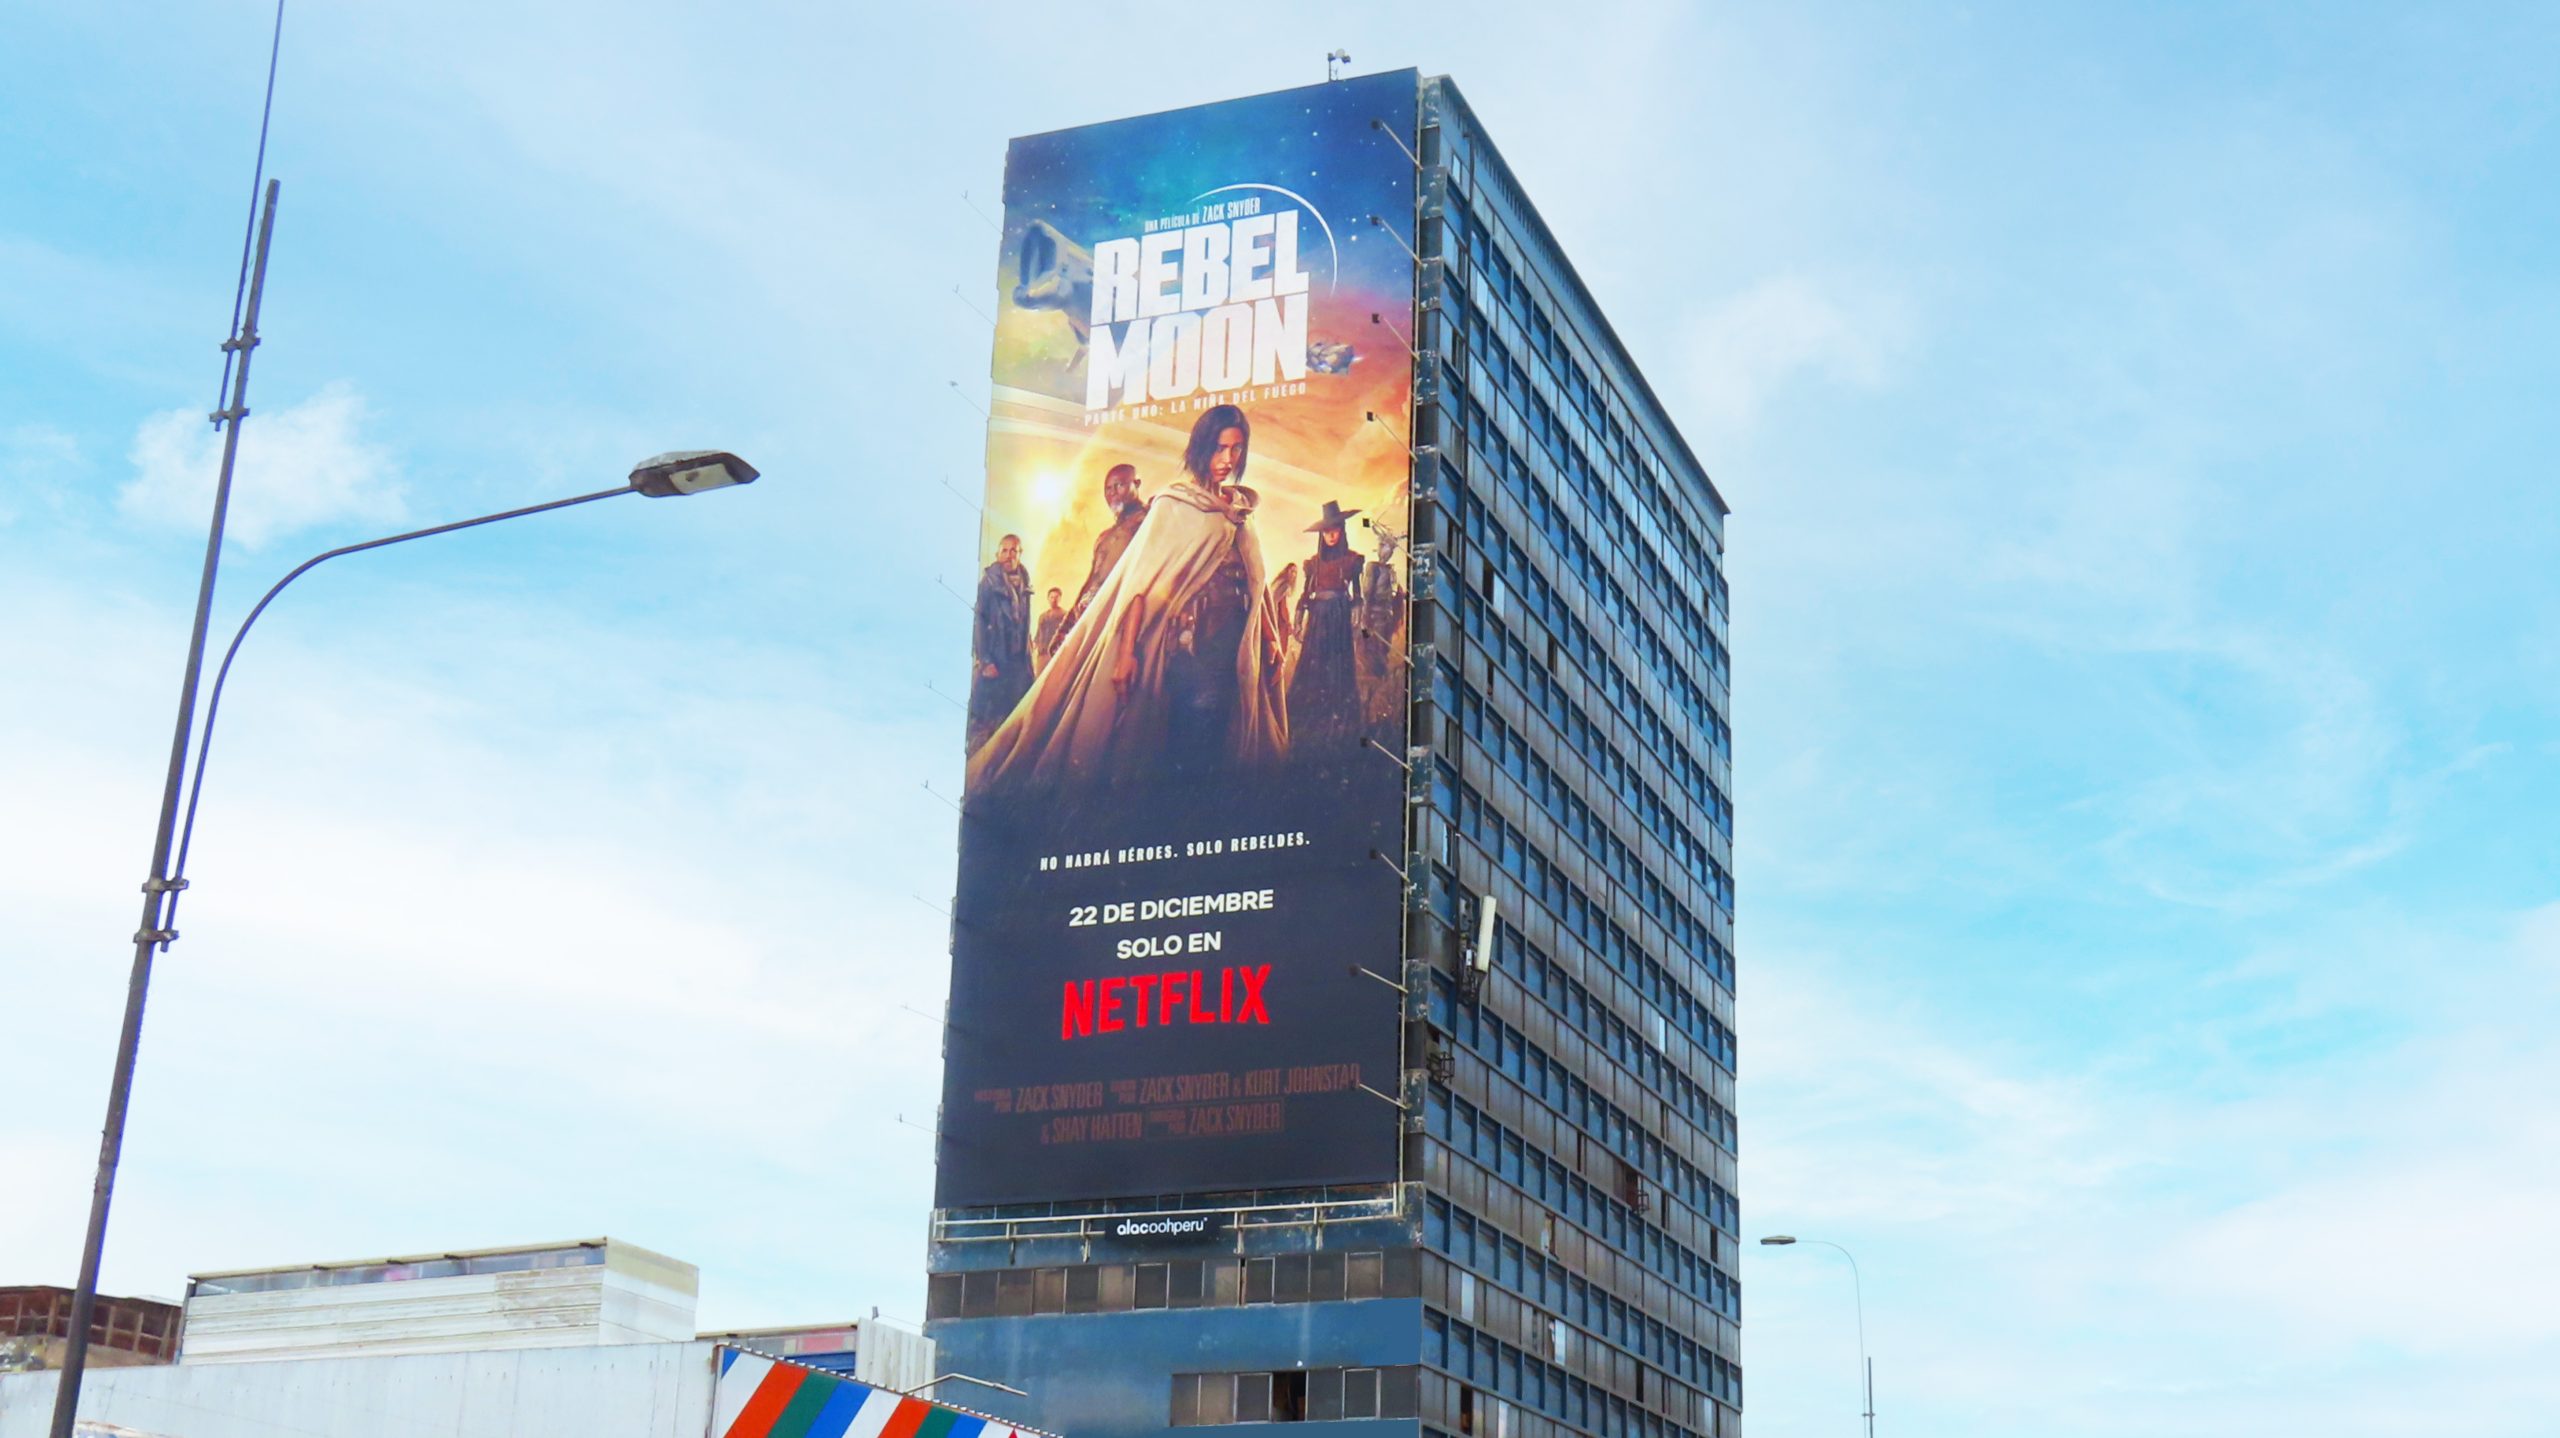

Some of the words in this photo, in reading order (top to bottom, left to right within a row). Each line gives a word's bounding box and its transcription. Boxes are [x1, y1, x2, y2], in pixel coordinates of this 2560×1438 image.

[1144, 220, 1158, 233] UNA
[1202, 204, 1225, 222] ZACK
[1227, 197, 1261, 218] SNYDER
[1090, 209, 1309, 326] REBEL
[1086, 292, 1309, 412] MOON
[1084, 409, 1125, 427] PARTE
[1132, 405, 1163, 420] UNO:
[1170, 400, 1186, 414] LA
[1233, 389, 1257, 405] DEL
[1264, 382, 1306, 400] FUEGO
[1040, 856, 1058, 871] NO
[1065, 850, 1111, 868] HABRÁ
[1118, 846, 1178, 864] HÉROES.
[1186, 840, 1223, 857] SOLO
[1231, 831, 1311, 852] REBELDES.
[1068, 905, 1098, 926] 22
[1103, 902, 1135, 924] DE
[1140, 889, 1274, 921] DICIEMBRE
[1116, 934, 1183, 959] SOLO
[1188, 931, 1221, 953] EN
[1061, 963, 1272, 1041] NETFLIX
[1015, 1086, 1050, 1113] ZACK
[1051, 1081, 1104, 1110] SNYDER
[1140, 1076, 1175, 1104] ZACK
[1176, 1072, 1229, 1100] SNYDER
[1244, 1068, 1281, 1096] KURT
[1053, 1115, 1088, 1143] SHAY
[1091, 1111, 1143, 1140] HATTEN
[1188, 1107, 1223, 1135] ZACK
[1226, 1102, 1281, 1131] SNYDER
